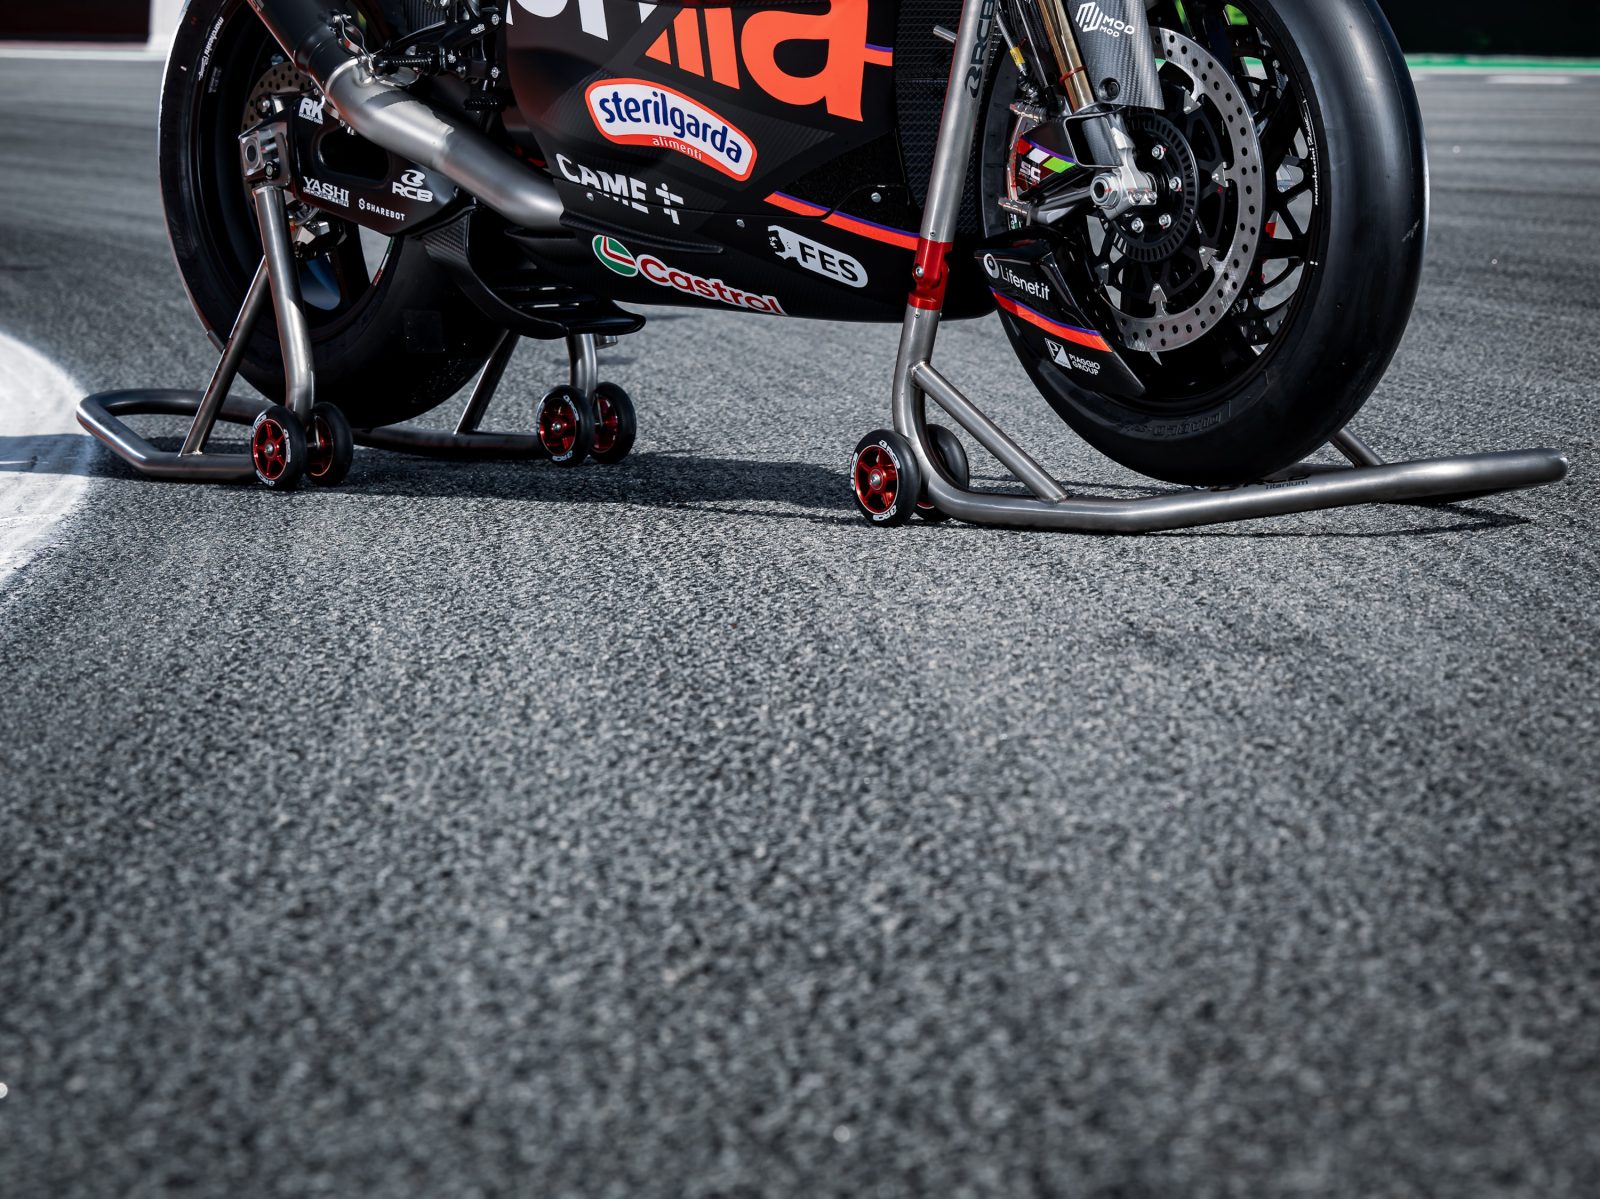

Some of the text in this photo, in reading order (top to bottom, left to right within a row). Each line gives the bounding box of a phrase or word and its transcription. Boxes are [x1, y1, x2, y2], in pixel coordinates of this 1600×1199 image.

[1099, 25, 1120, 38] MOD
[1103, 15, 1135, 35] MOD
[299, 97, 325, 121] RK
[599, 91, 743, 164] sterilgarda
[652, 136, 702, 161] alimenti
[556, 153, 649, 214] CAME
[1020, 161, 1041, 182] SC
[303, 176, 350, 202] YASHI
[392, 182, 433, 202] RCB
[366, 202, 406, 221] SHAREBOT
[798, 240, 860, 282] FES
[640, 258, 783, 314] Castrol
[1000, 264, 1050, 300] Lifenet.it
[1069, 353, 1101, 371] PIAGGIO
